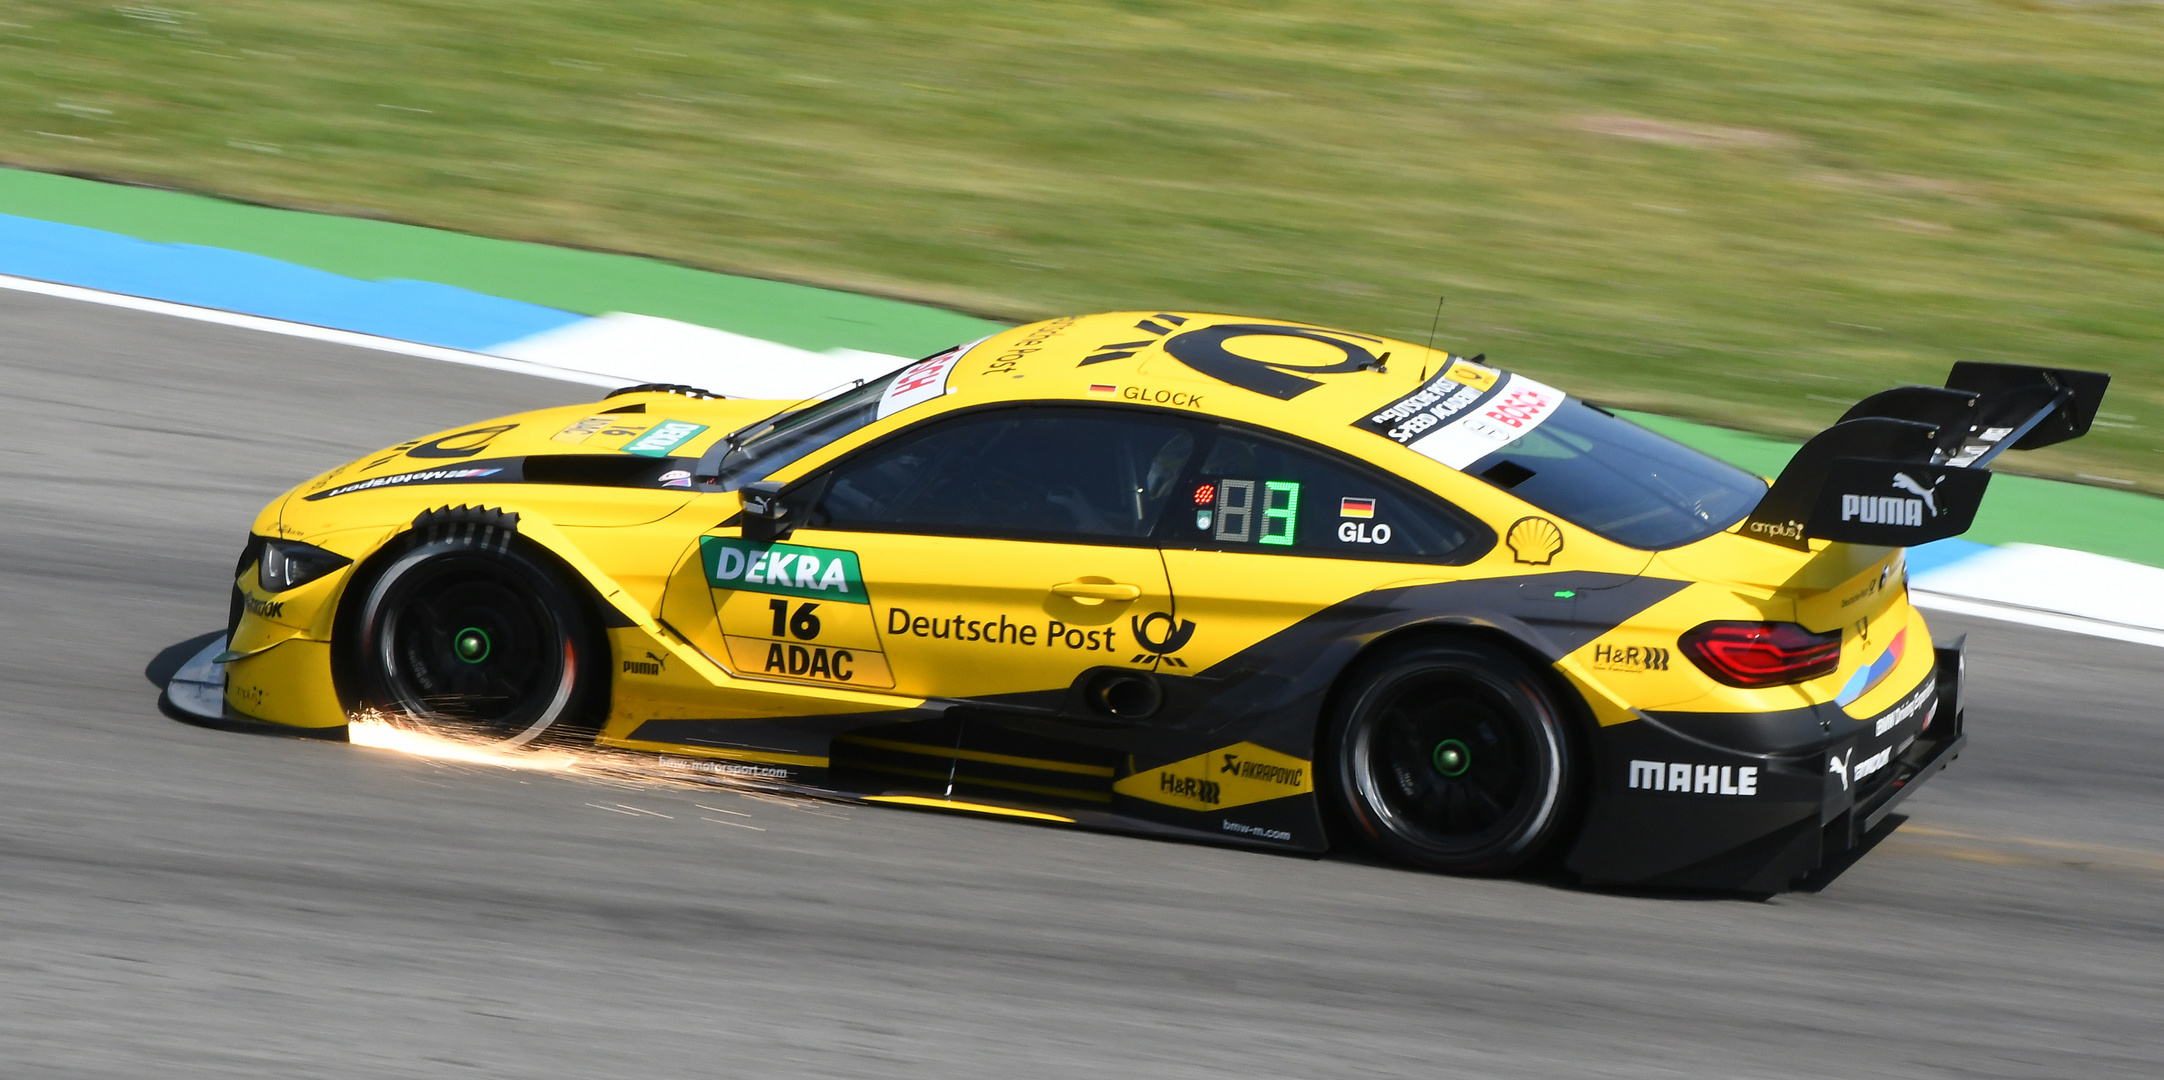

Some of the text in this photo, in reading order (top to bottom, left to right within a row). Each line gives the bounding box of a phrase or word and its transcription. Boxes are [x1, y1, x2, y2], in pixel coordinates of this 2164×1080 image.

[981, 348, 1042, 376] Post
[1123, 386, 1204, 408] GLOCK
[1485, 387, 1550, 428] BOSCH
[601, 425, 647, 436] 16
[1388, 412, 1438, 443] SPEED
[328, 470, 447, 497] Motorsport
[1841, 493, 1924, 528] PUMA
[1337, 521, 1392, 545] GLO
[1750, 521, 1797, 538] amplus
[716, 546, 849, 593] DEKRA
[769, 598, 821, 641] 16
[888, 607, 1116, 653] Deutsche Post
[623, 660, 659, 676] PUMA
[764, 642, 853, 681] ADAC
[1595, 643, 1639, 666] H&R
[659, 755, 787, 778] bmw-motorsport.com
[1629, 759, 1759, 796] MAHLE
[1160, 771, 1198, 798] H&R
[1223, 819, 1291, 841] bmw-m.com
